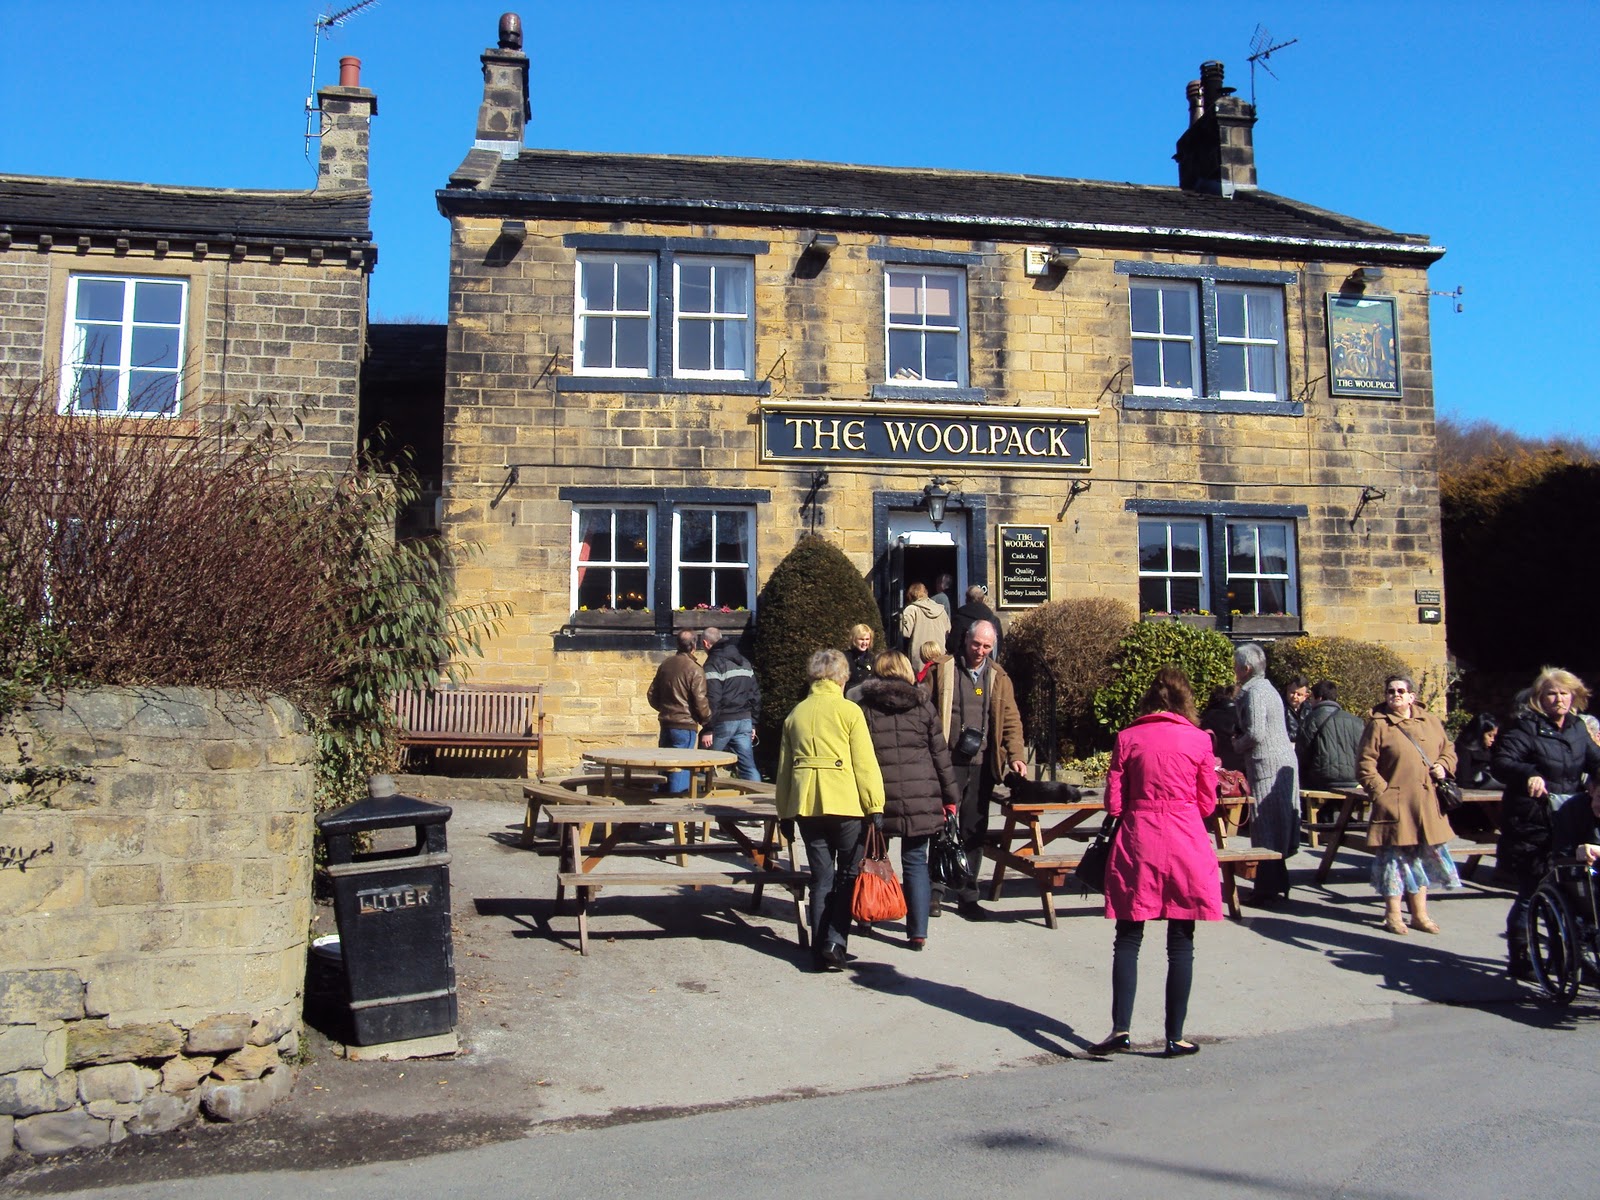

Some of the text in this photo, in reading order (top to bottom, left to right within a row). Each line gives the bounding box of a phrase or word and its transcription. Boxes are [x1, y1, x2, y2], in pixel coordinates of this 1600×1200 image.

[1337, 379, 1395, 389] THE WOOLPACK
[785, 418, 1071, 457] THE WOOLPACK
[1016, 533, 1033, 541] THE
[1004, 540, 1045, 548] WOOLPACK
[1015, 567, 1035, 575] Quality
[1004, 589, 1024, 597] Sunday
[359, 889, 430, 911] LITTER
